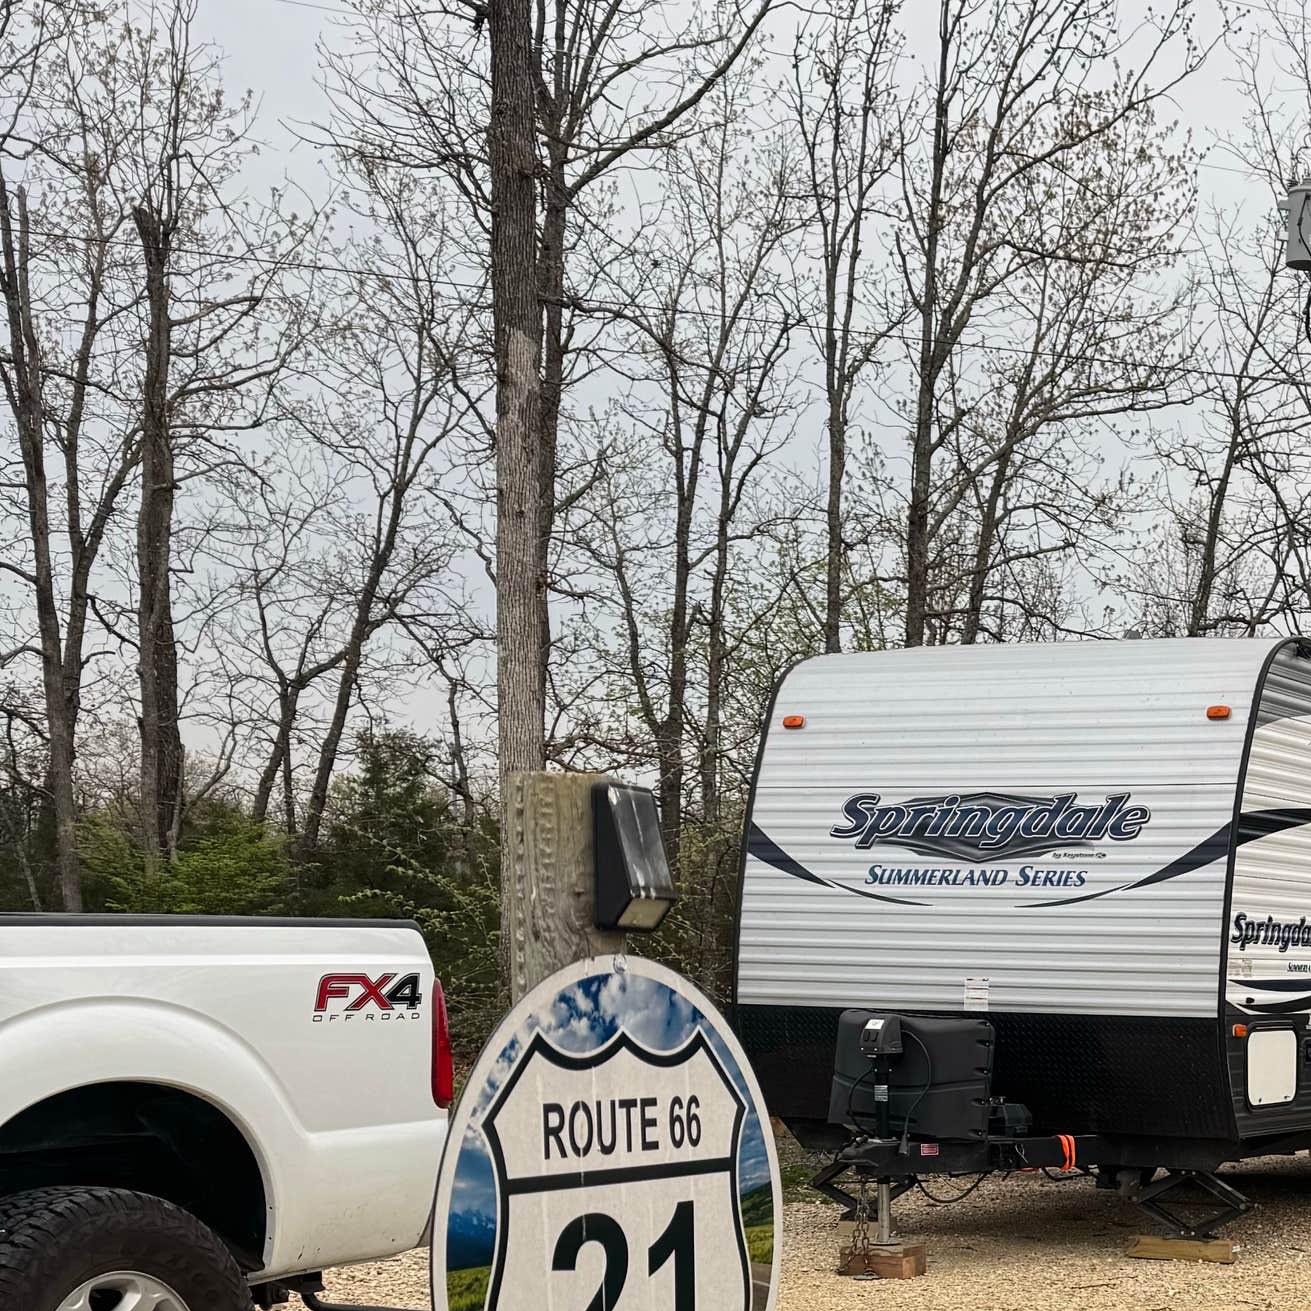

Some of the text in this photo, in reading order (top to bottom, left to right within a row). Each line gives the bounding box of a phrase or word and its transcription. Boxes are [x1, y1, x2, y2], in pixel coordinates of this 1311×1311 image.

[830, 792, 1151, 850] Springdale
[864, 864, 1088, 887] SUMMERLAND SERIES
[313, 972, 423, 1012] FX4
[312, 1012, 421, 1022] OFF ROAD
[542, 1094, 702, 1160] ROUTE 66
